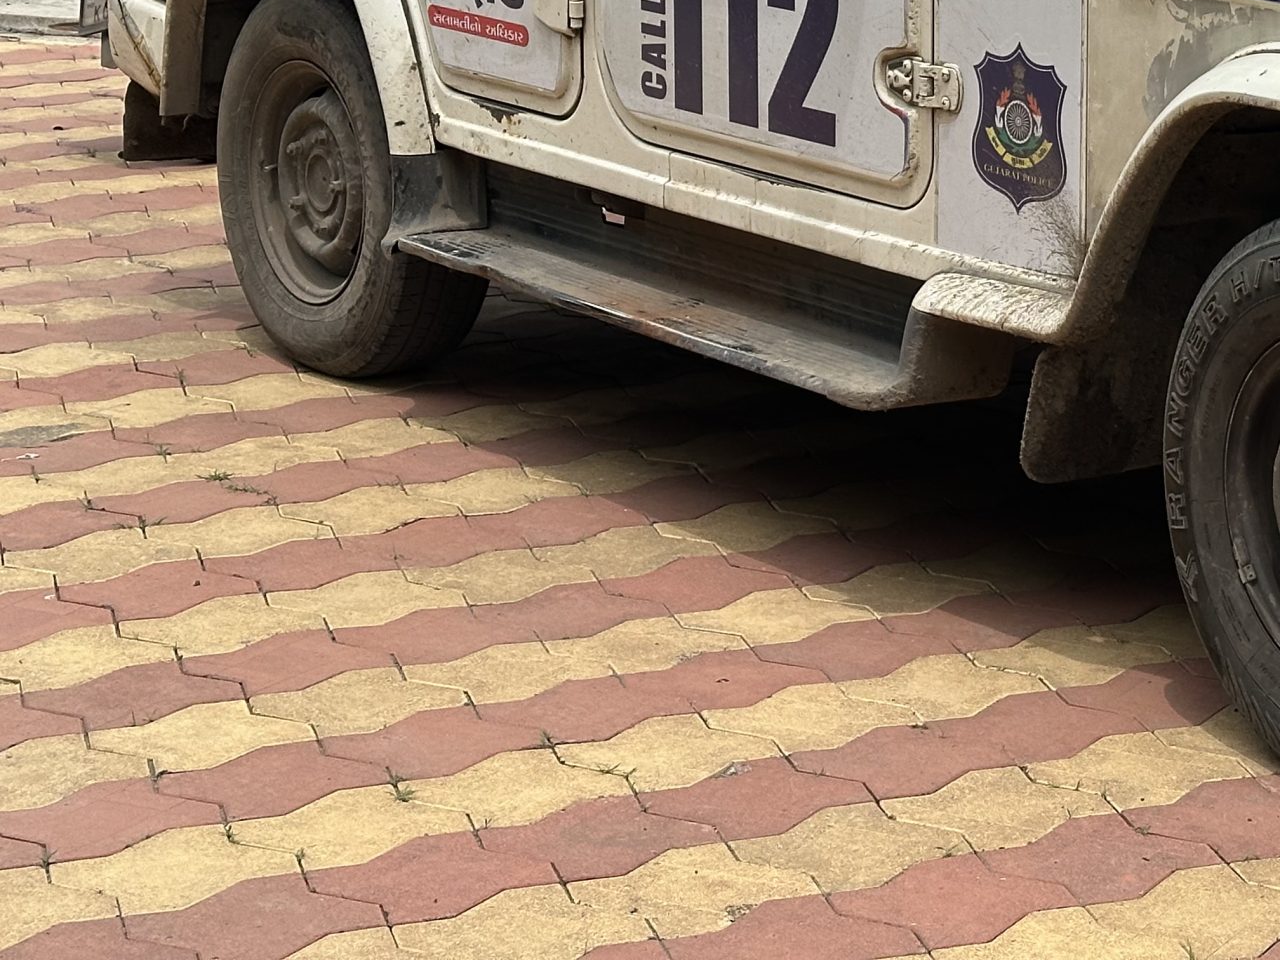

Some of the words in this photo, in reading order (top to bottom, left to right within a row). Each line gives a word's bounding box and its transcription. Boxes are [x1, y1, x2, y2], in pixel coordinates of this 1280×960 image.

[433, 13, 482, 33] સલામતીનો
[485, 23, 524, 43] અધિકાર
[1163, 293, 1230, 530] RANGER
